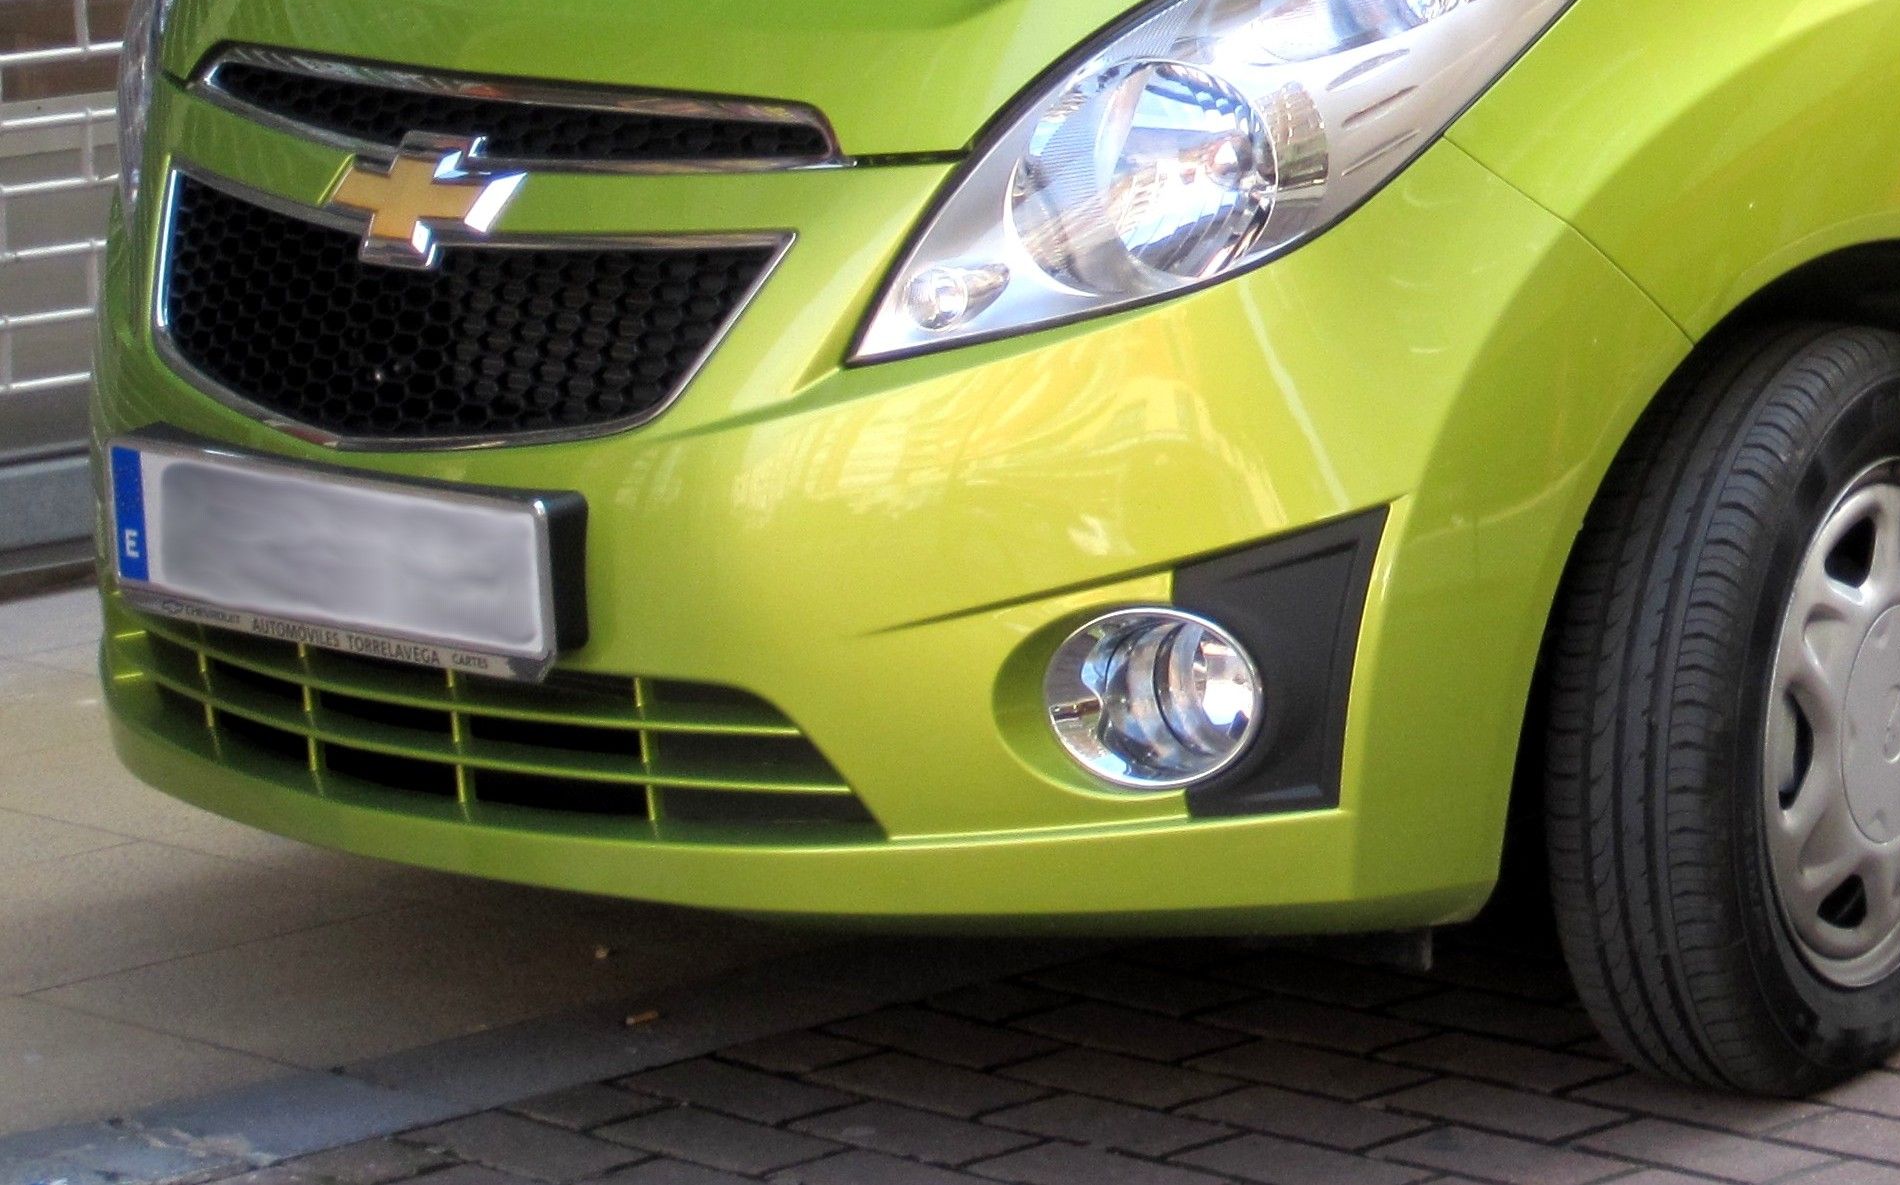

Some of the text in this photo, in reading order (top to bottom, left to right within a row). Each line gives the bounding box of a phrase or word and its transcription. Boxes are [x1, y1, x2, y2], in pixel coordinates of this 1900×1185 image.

[125, 528, 140, 558] E
[252, 618, 340, 647] AUTOMOVILES
[347, 633, 441, 665] TORRELAVEGA
